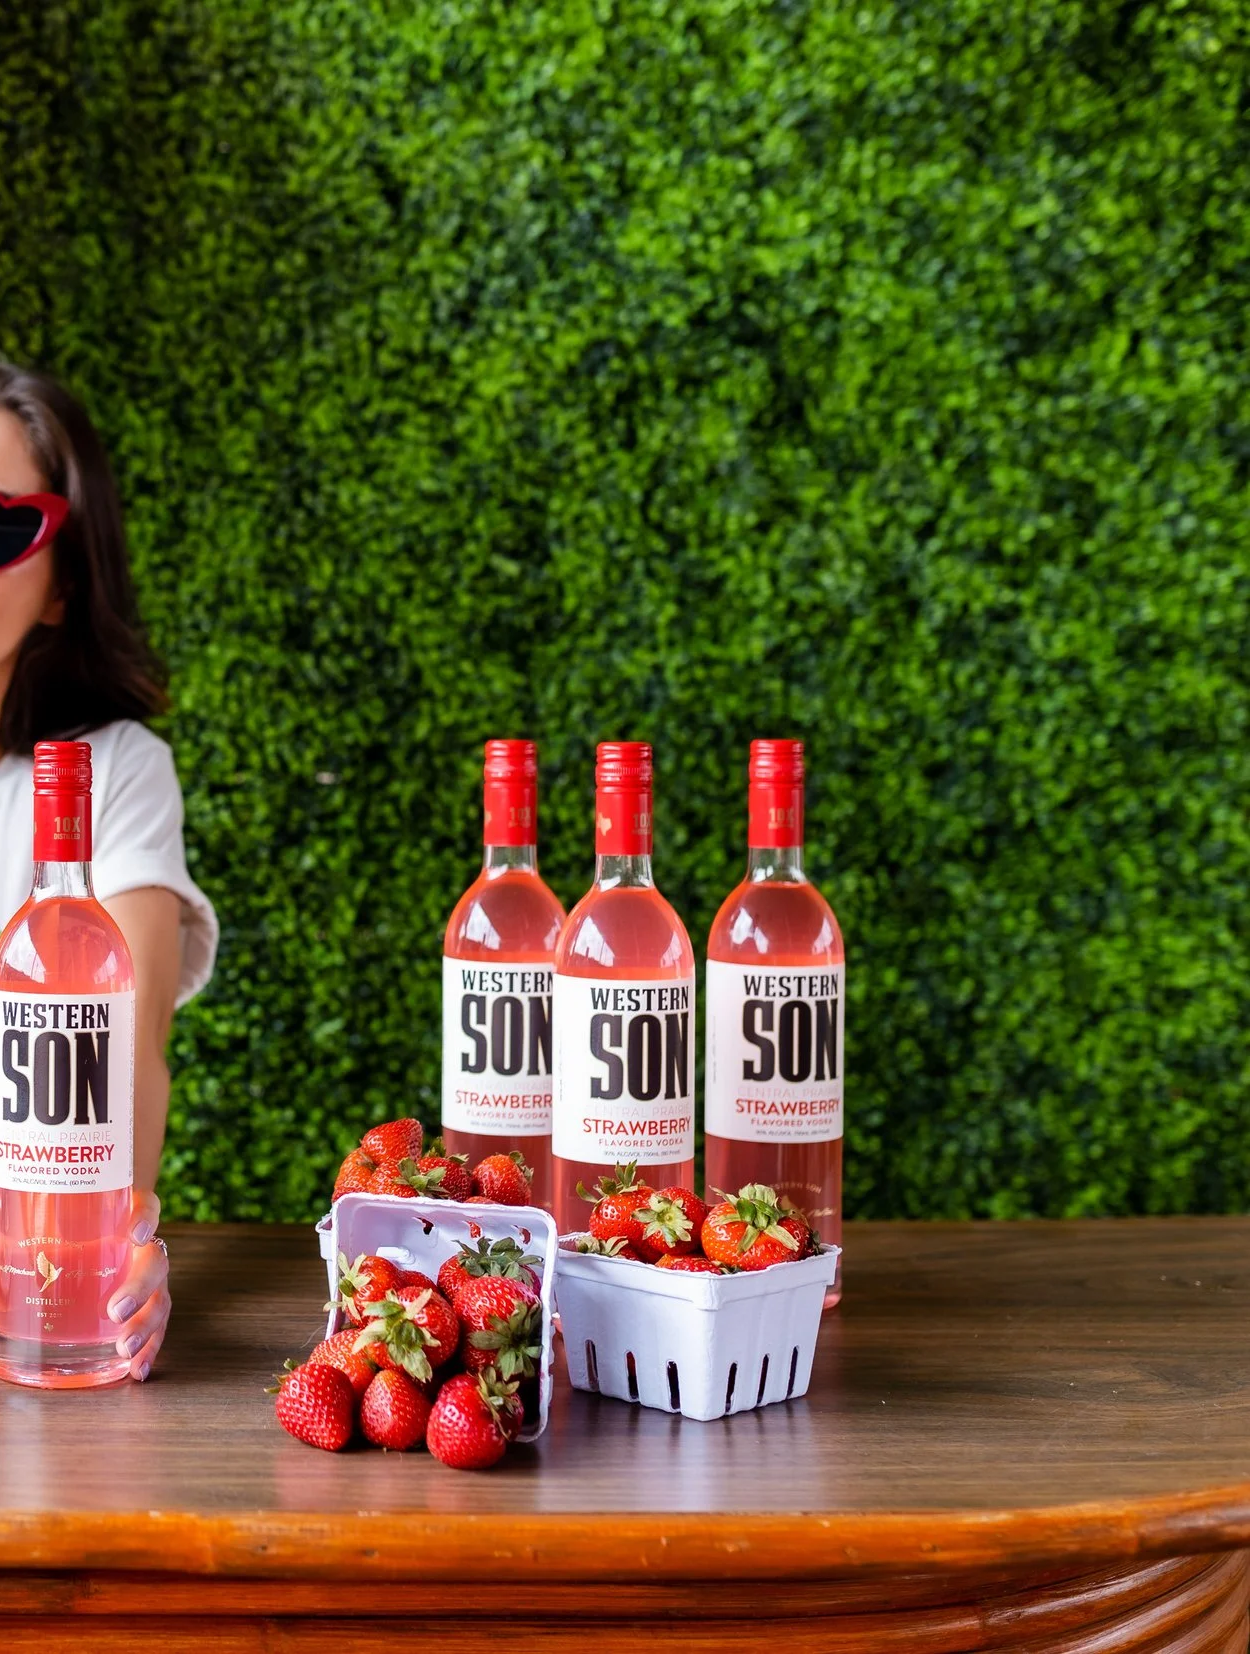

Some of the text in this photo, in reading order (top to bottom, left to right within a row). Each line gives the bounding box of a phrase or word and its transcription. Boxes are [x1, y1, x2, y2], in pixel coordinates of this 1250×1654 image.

[54, 816, 81, 833] 10X
[743, 973, 838, 997] WESTERN
[590, 986, 689, 1012] WESTERN
[2, 1001, 110, 1029] WESTERN
[742, 999, 838, 1083] SON
[590, 1013, 689, 1102] SON
[2, 1029, 110, 1126] SON
[455, 1089, 552, 1109] STRAWBERR
[736, 1097, 839, 1116] STRAWBERRY
[582, 1117, 691, 1136] STRAWBERRY
[750, 1118, 803, 1127] FLAVORED
[598, 1137, 683, 1147] FLAVORED VODKA
[8, 1164, 101, 1175] FLAVORED VODKA
[18, 1237, 62, 1248] WESTERN
